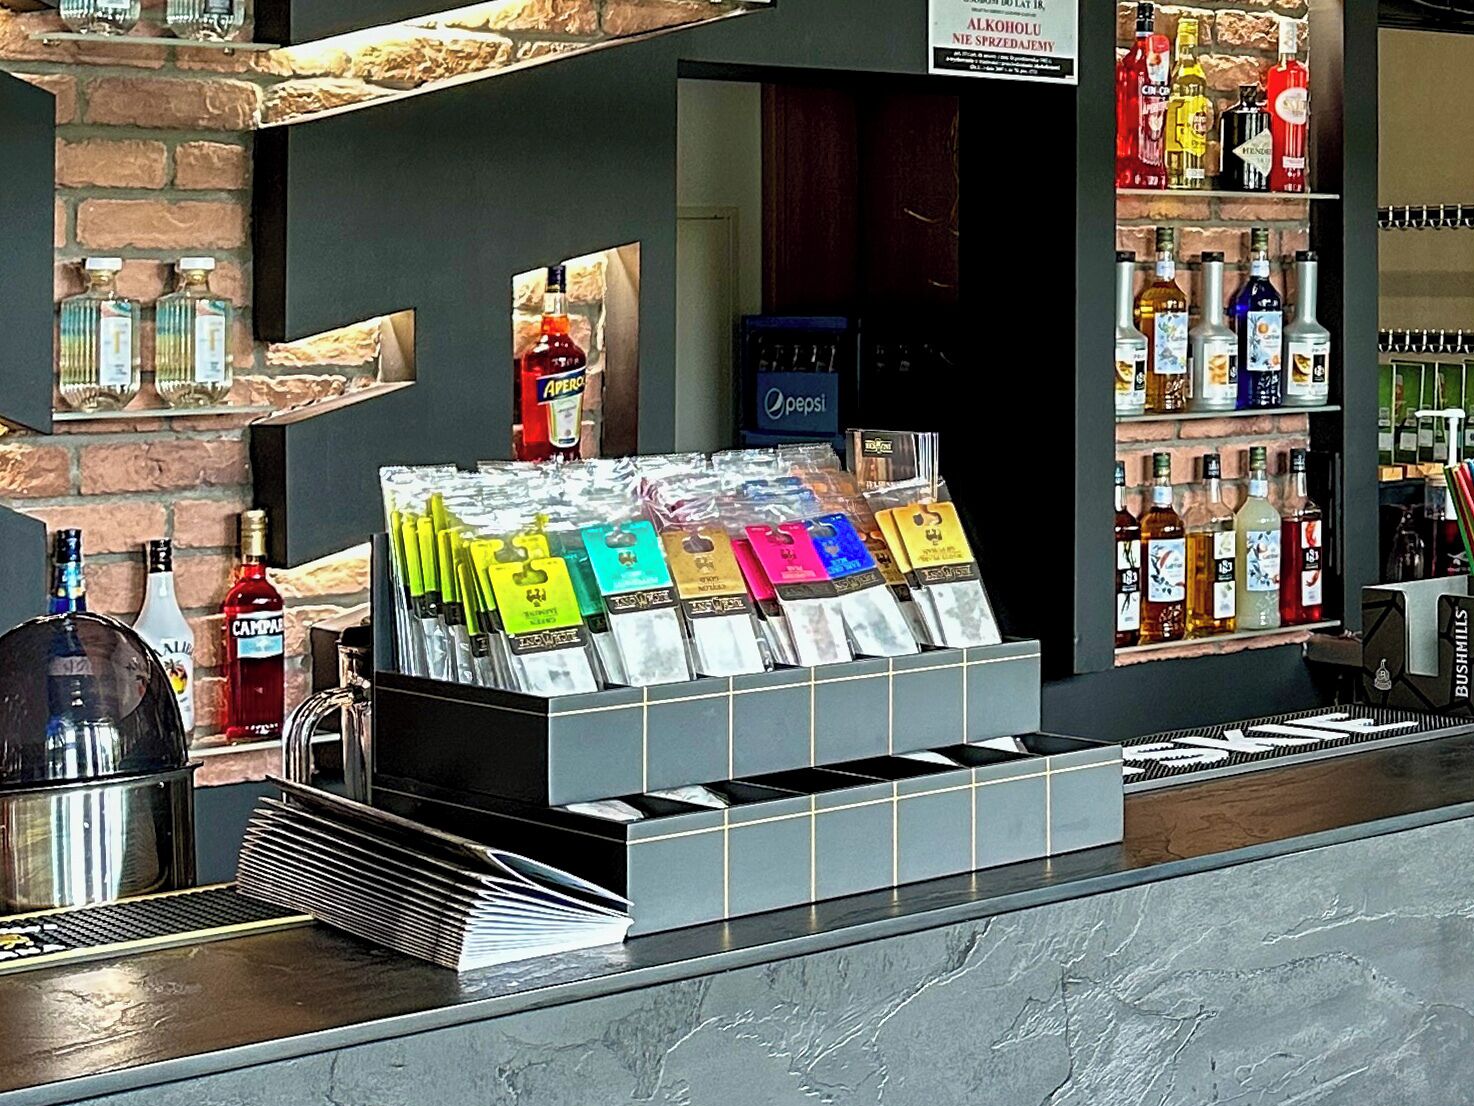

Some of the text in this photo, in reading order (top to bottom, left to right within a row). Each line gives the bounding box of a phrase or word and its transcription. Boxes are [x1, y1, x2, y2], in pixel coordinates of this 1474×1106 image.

[967, 18, 1042, 36] ALKOHOLU
[952, 33, 1056, 52] NIE SPRZEDAJEMY
[786, 393, 826, 416] pepsi
[1455, 608, 1469, 698] BUSHMILLS
[1122, 712, 1420, 775] SKIE
